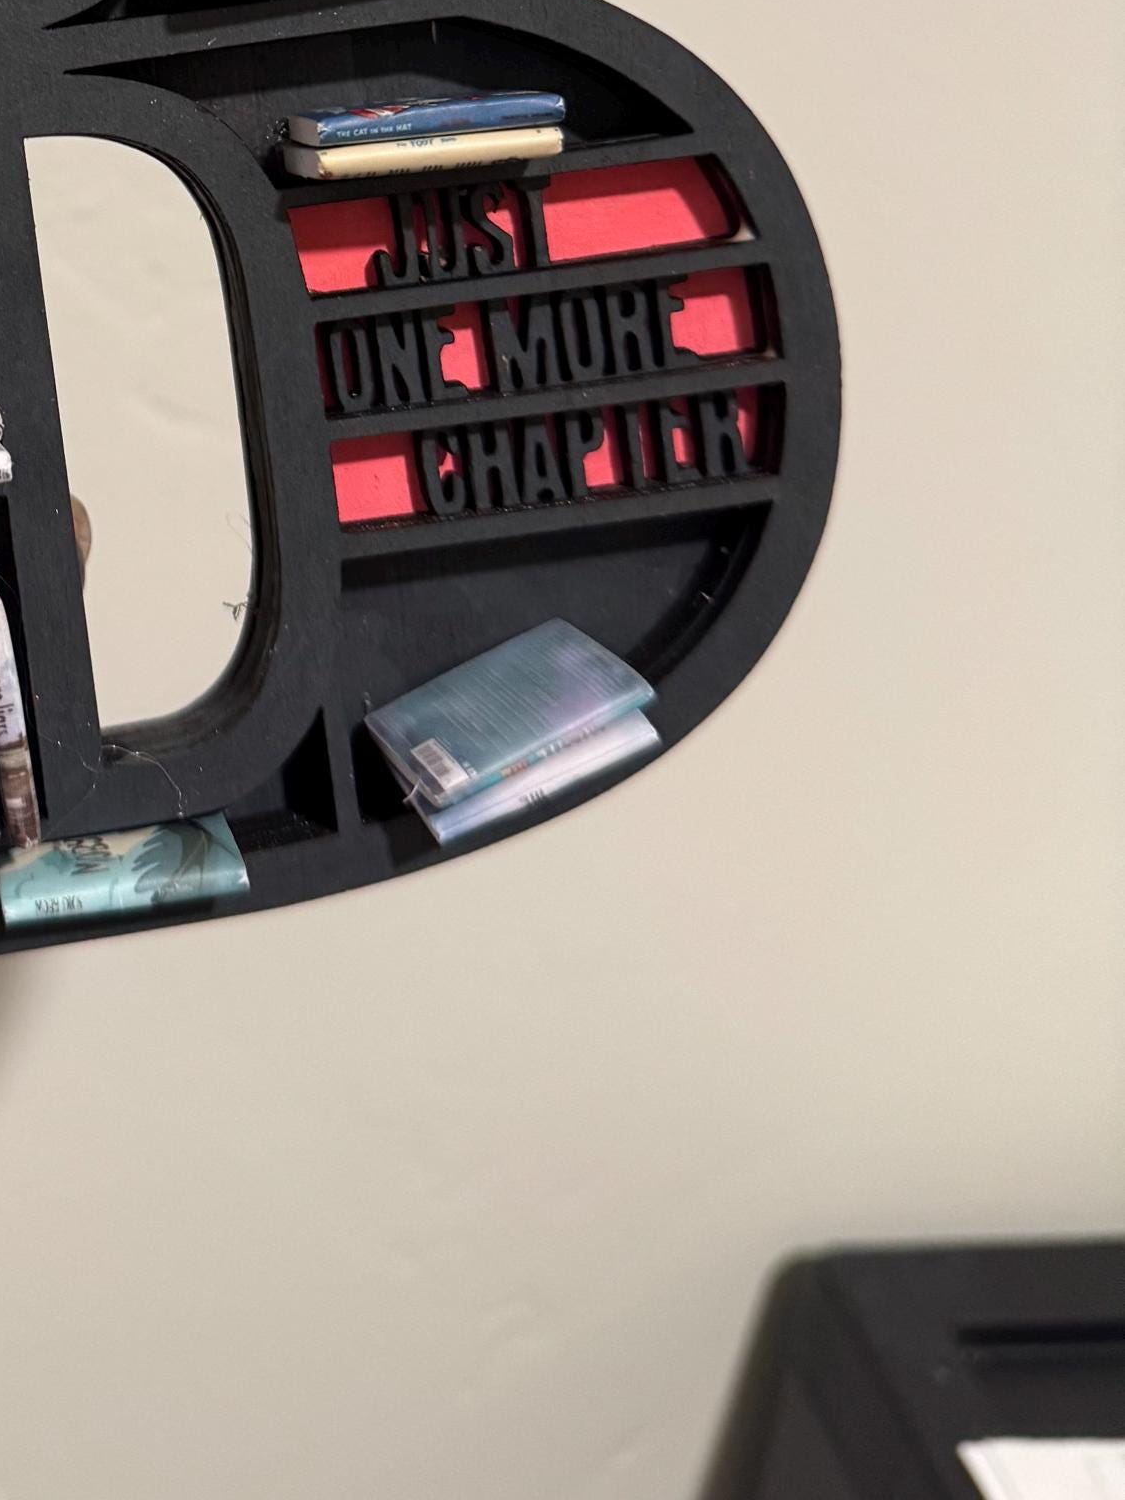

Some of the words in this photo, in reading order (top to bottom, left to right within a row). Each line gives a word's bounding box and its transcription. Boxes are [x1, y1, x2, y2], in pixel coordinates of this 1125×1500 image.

[336, 129, 351, 139] THE
[353, 127, 369, 136] CAT
[395, 123, 413, 132] HAT
[376, 180, 551, 286] JUST
[328, 306, 470, 412] ONE
[489, 275, 701, 396] MORE
[420, 390, 752, 516] CHAPTER
